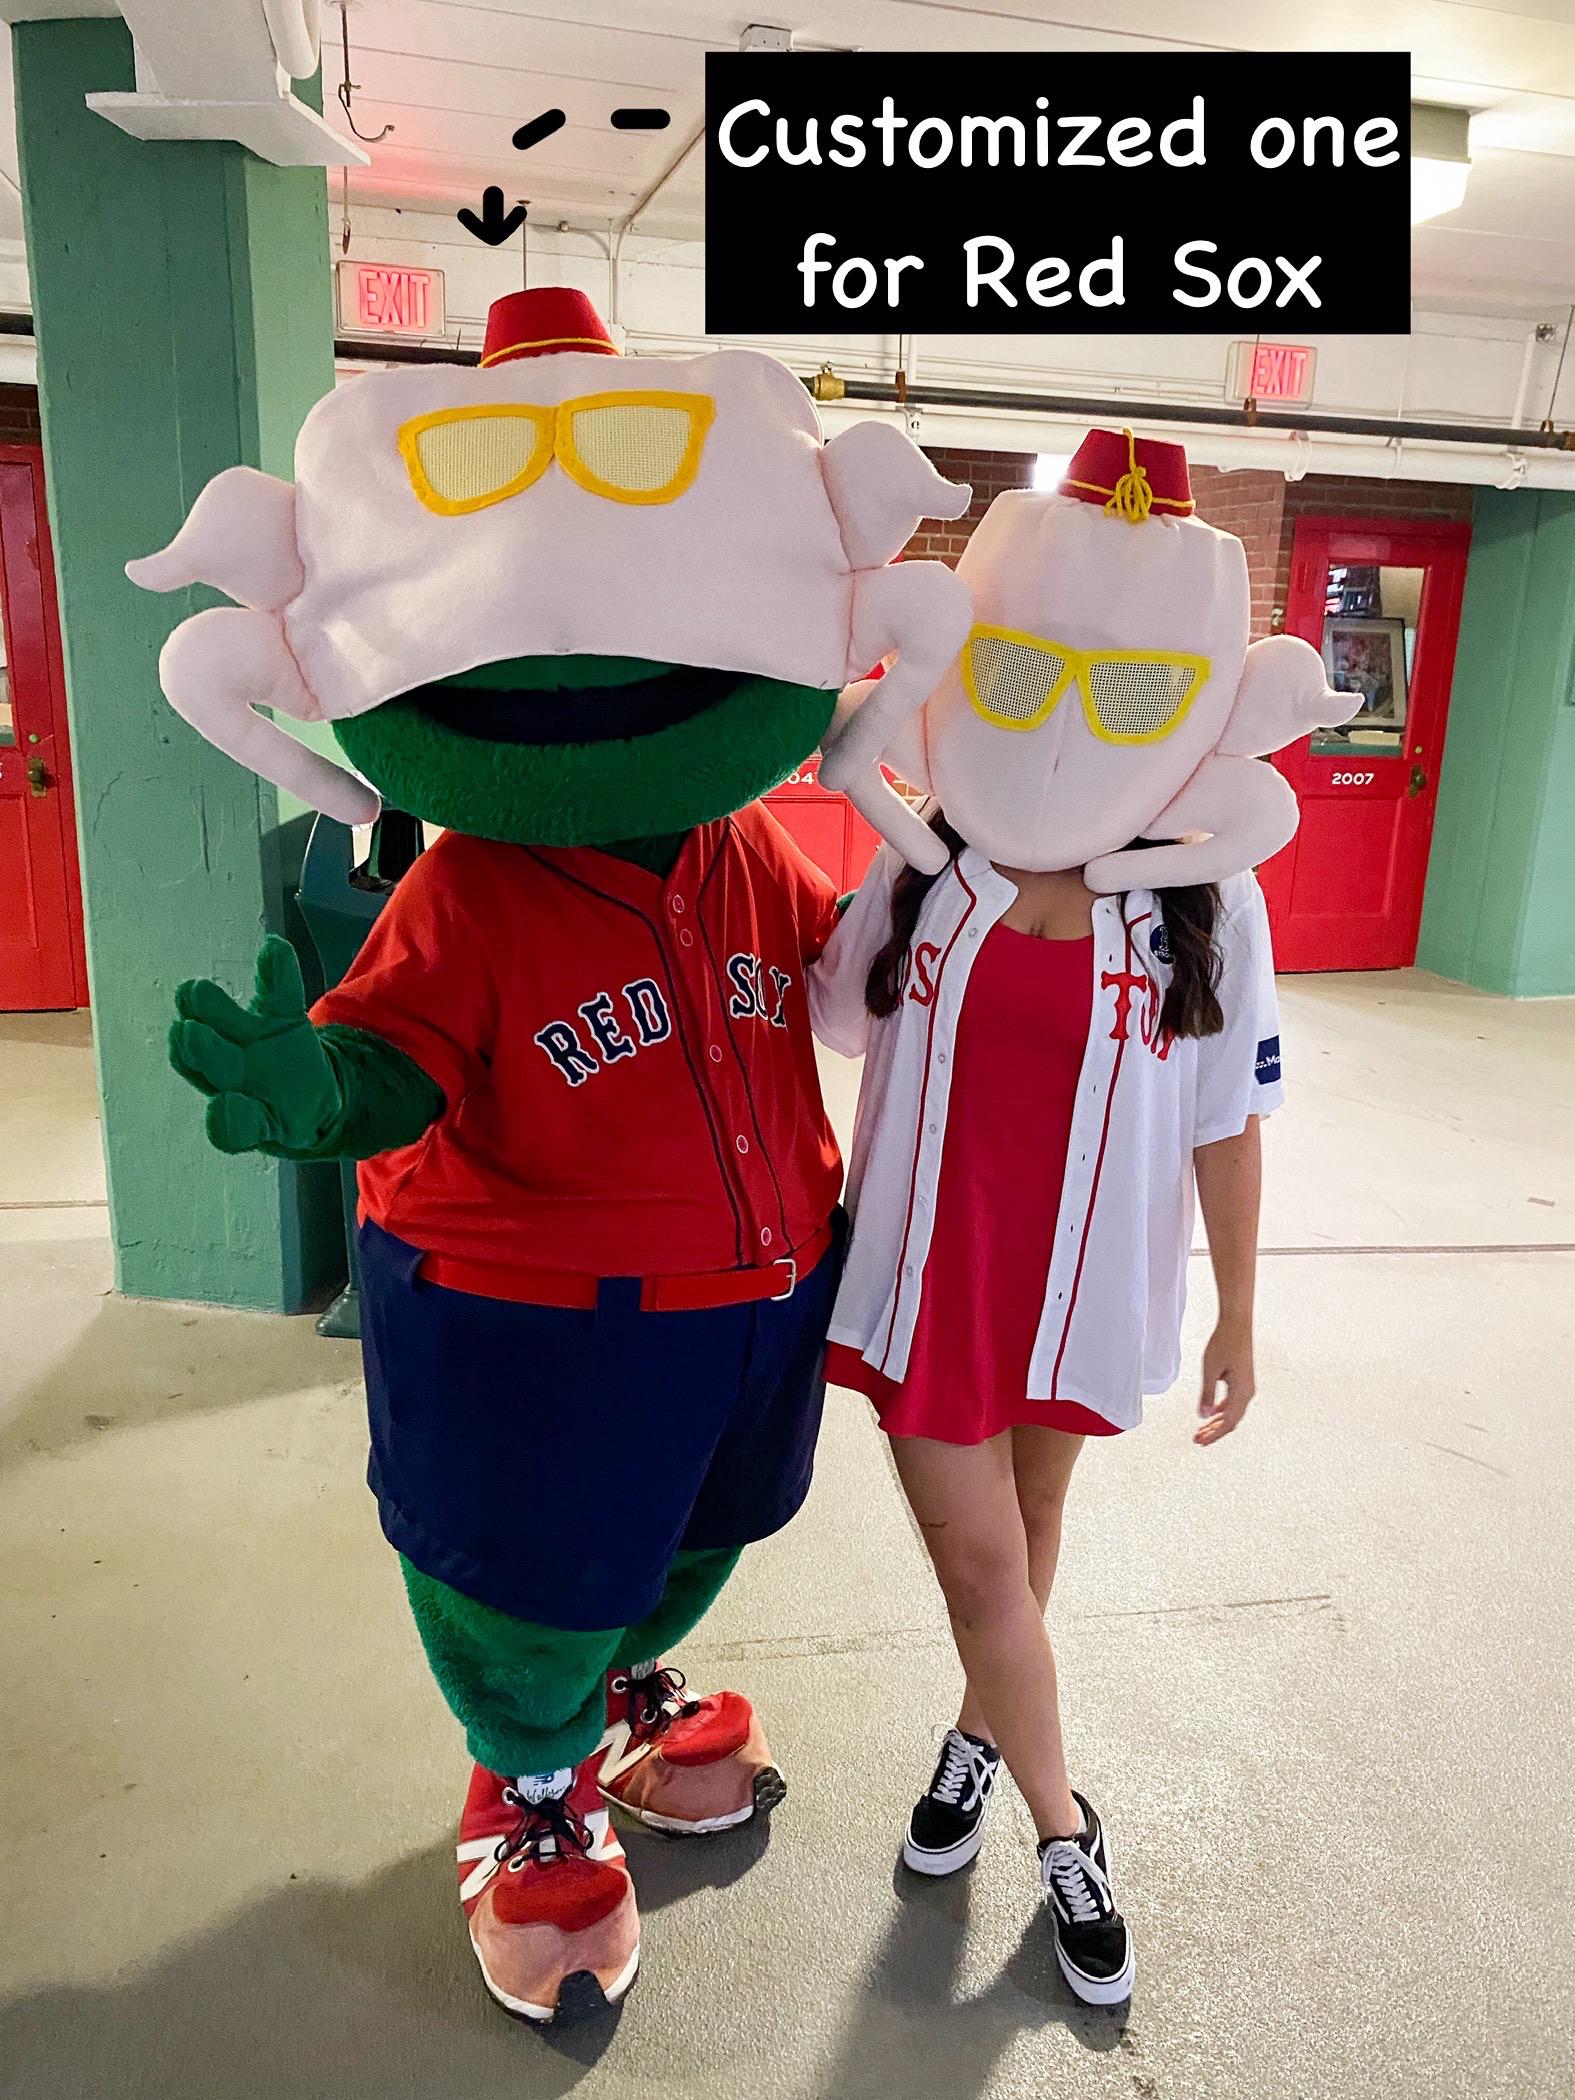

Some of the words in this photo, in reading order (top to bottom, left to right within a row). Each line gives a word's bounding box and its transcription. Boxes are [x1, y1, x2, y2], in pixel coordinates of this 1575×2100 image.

[358, 268, 430, 328] EXIT
[1251, 348, 1307, 396] EXIT
[1331, 772, 1374, 785] 2007
[533, 977, 672, 1087] RED
